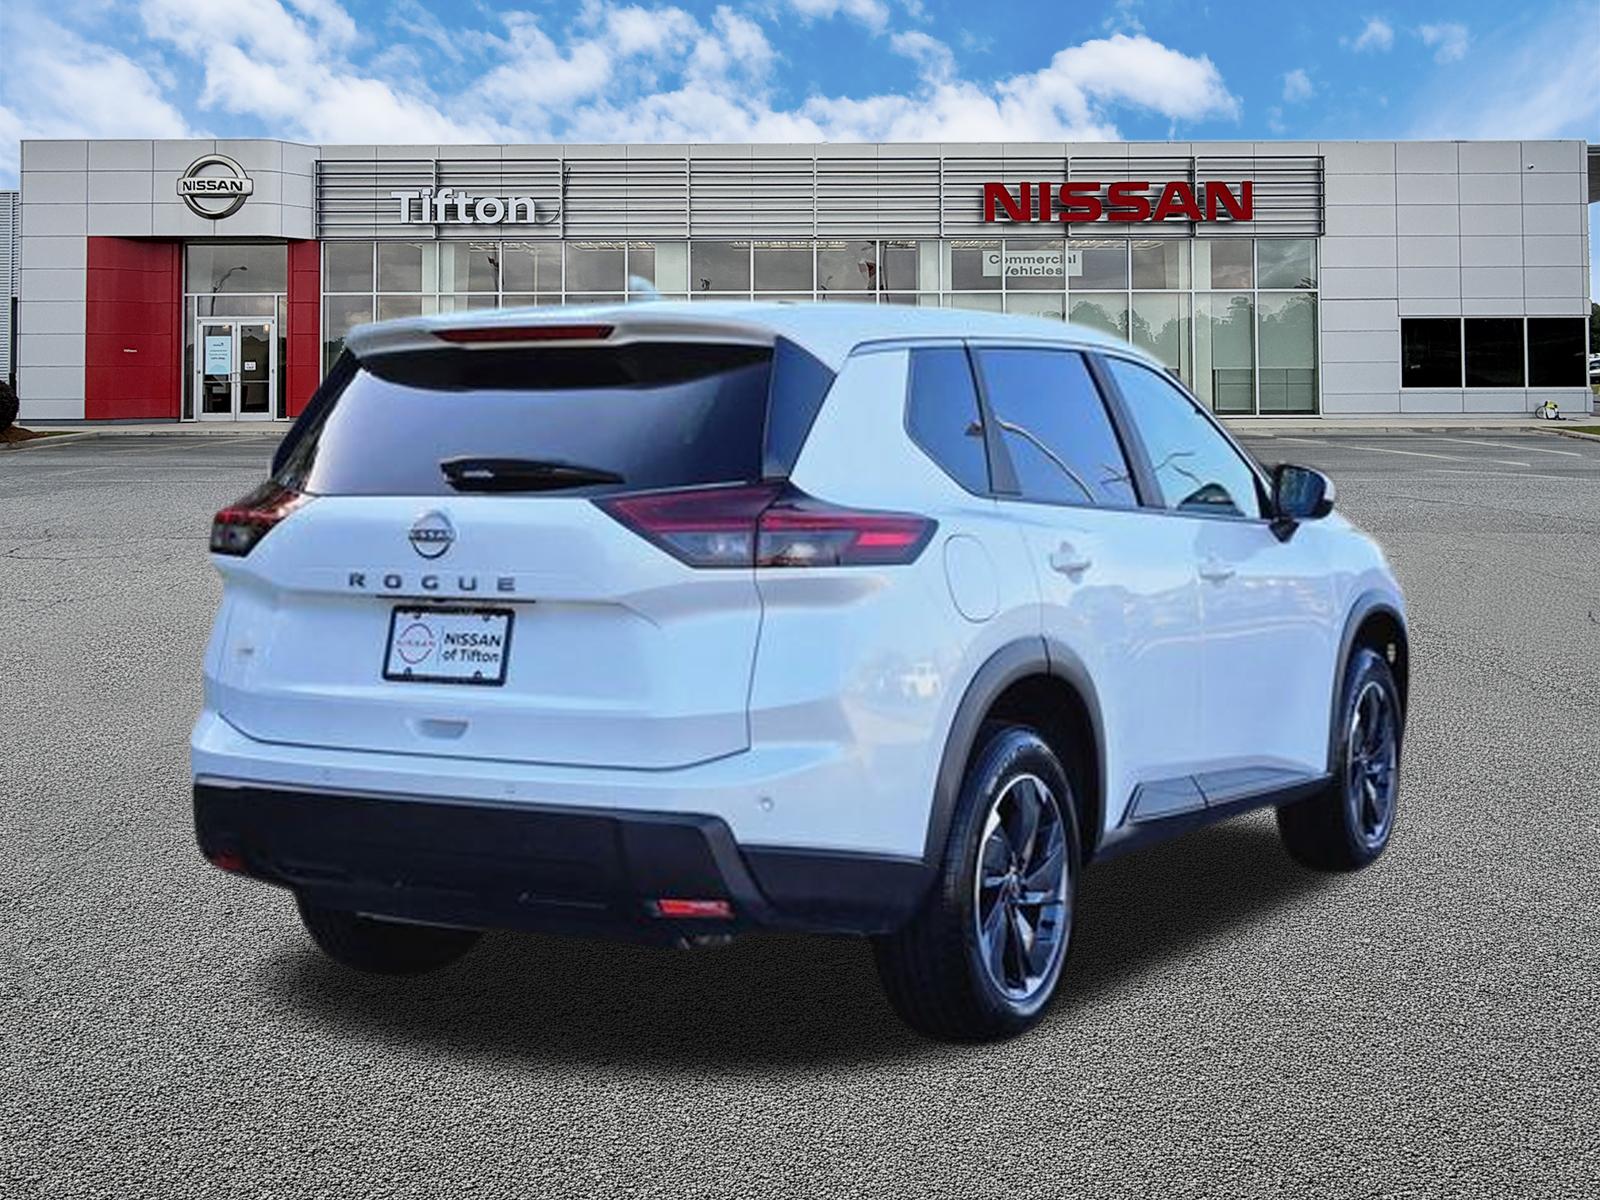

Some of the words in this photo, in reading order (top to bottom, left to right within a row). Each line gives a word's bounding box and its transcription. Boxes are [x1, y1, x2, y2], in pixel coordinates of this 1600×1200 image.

[182, 180, 243, 191] NISSAN
[391, 189, 535, 224] Tifton
[983, 181, 1253, 222] NISSAN
[348, 572, 516, 592] ROGUE
[444, 633, 501, 647] NISSAN
[442, 649, 457, 661] of
[459, 648, 499, 663] Tifton
